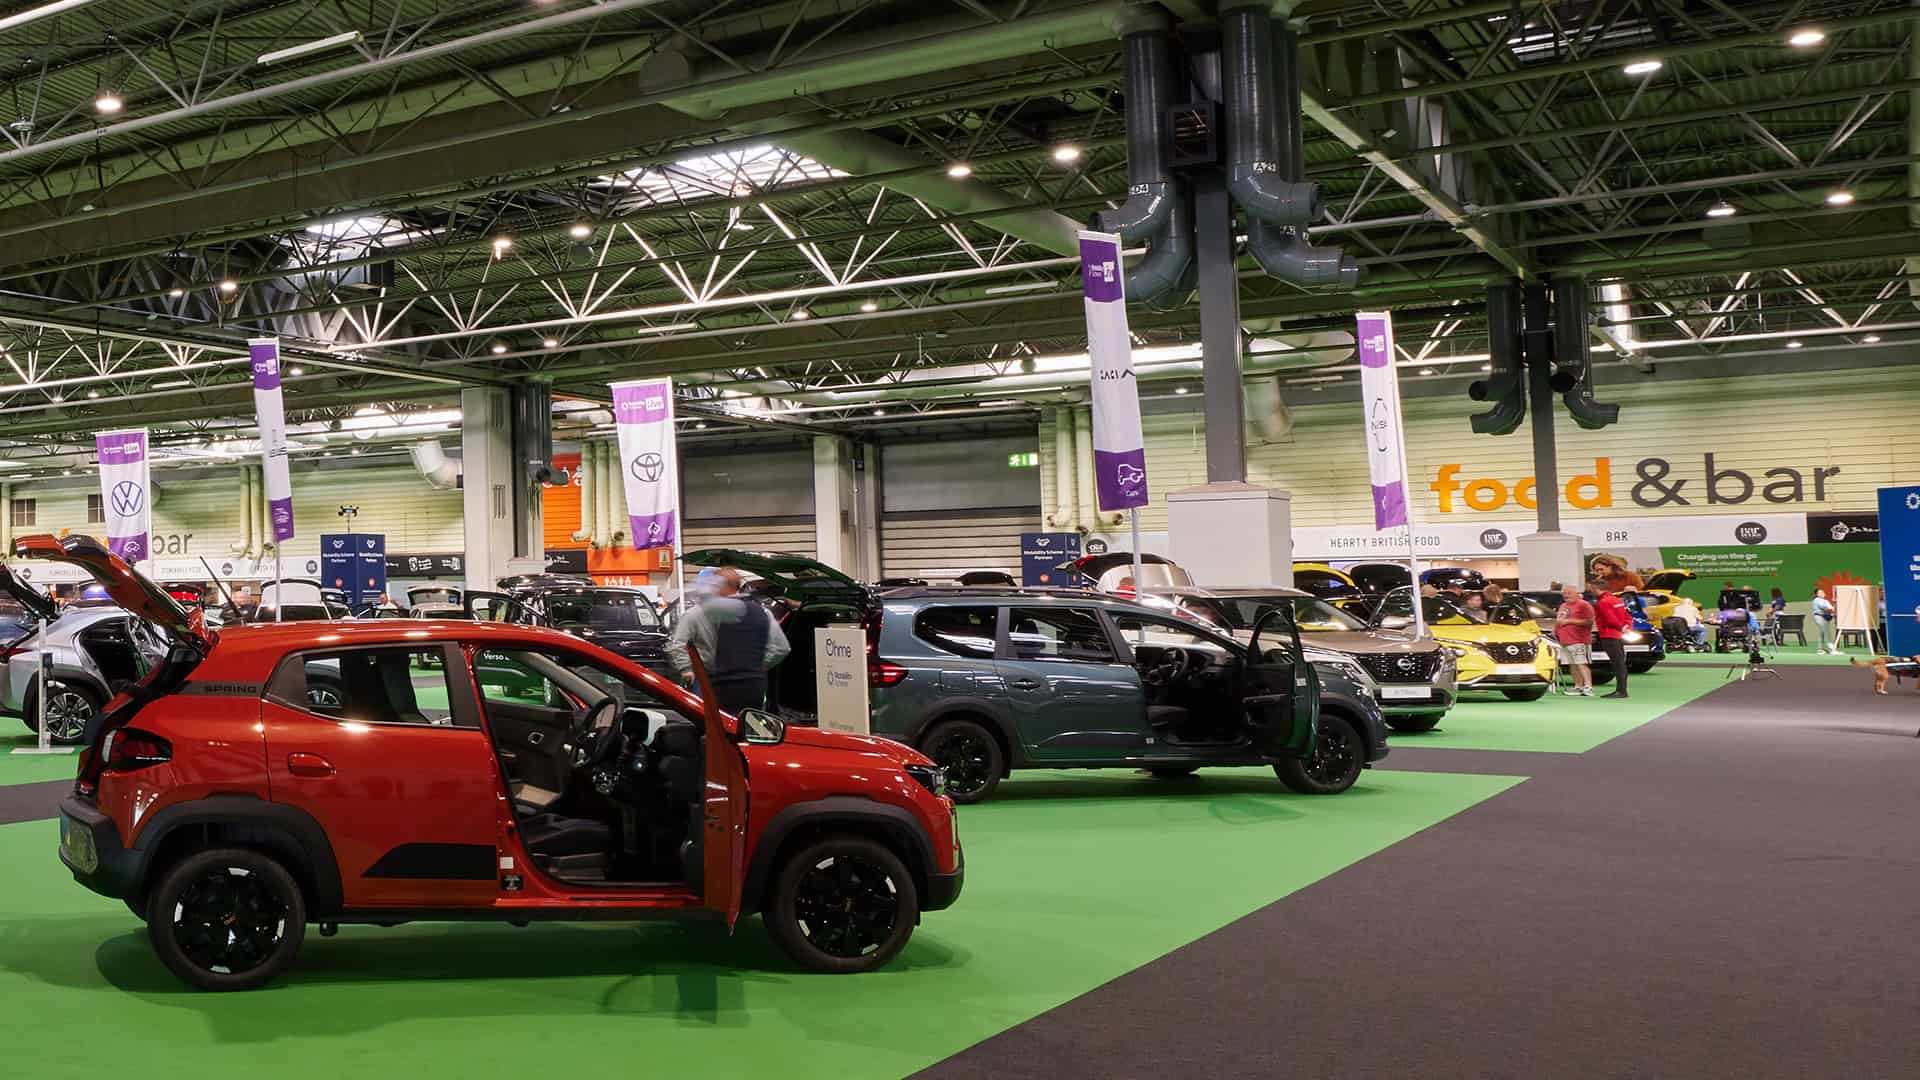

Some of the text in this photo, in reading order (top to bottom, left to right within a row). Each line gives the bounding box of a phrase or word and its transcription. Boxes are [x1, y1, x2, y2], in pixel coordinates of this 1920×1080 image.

[1631, 458, 1691, 508] &
[1704, 452, 1841, 505] bar
[1330, 535, 1440, 549] HEARTY BRITISH FOOD
[1606, 530, 1628, 542] BAR
[483, 652, 504, 661] Verso
[204, 685, 257, 693] SPRING
